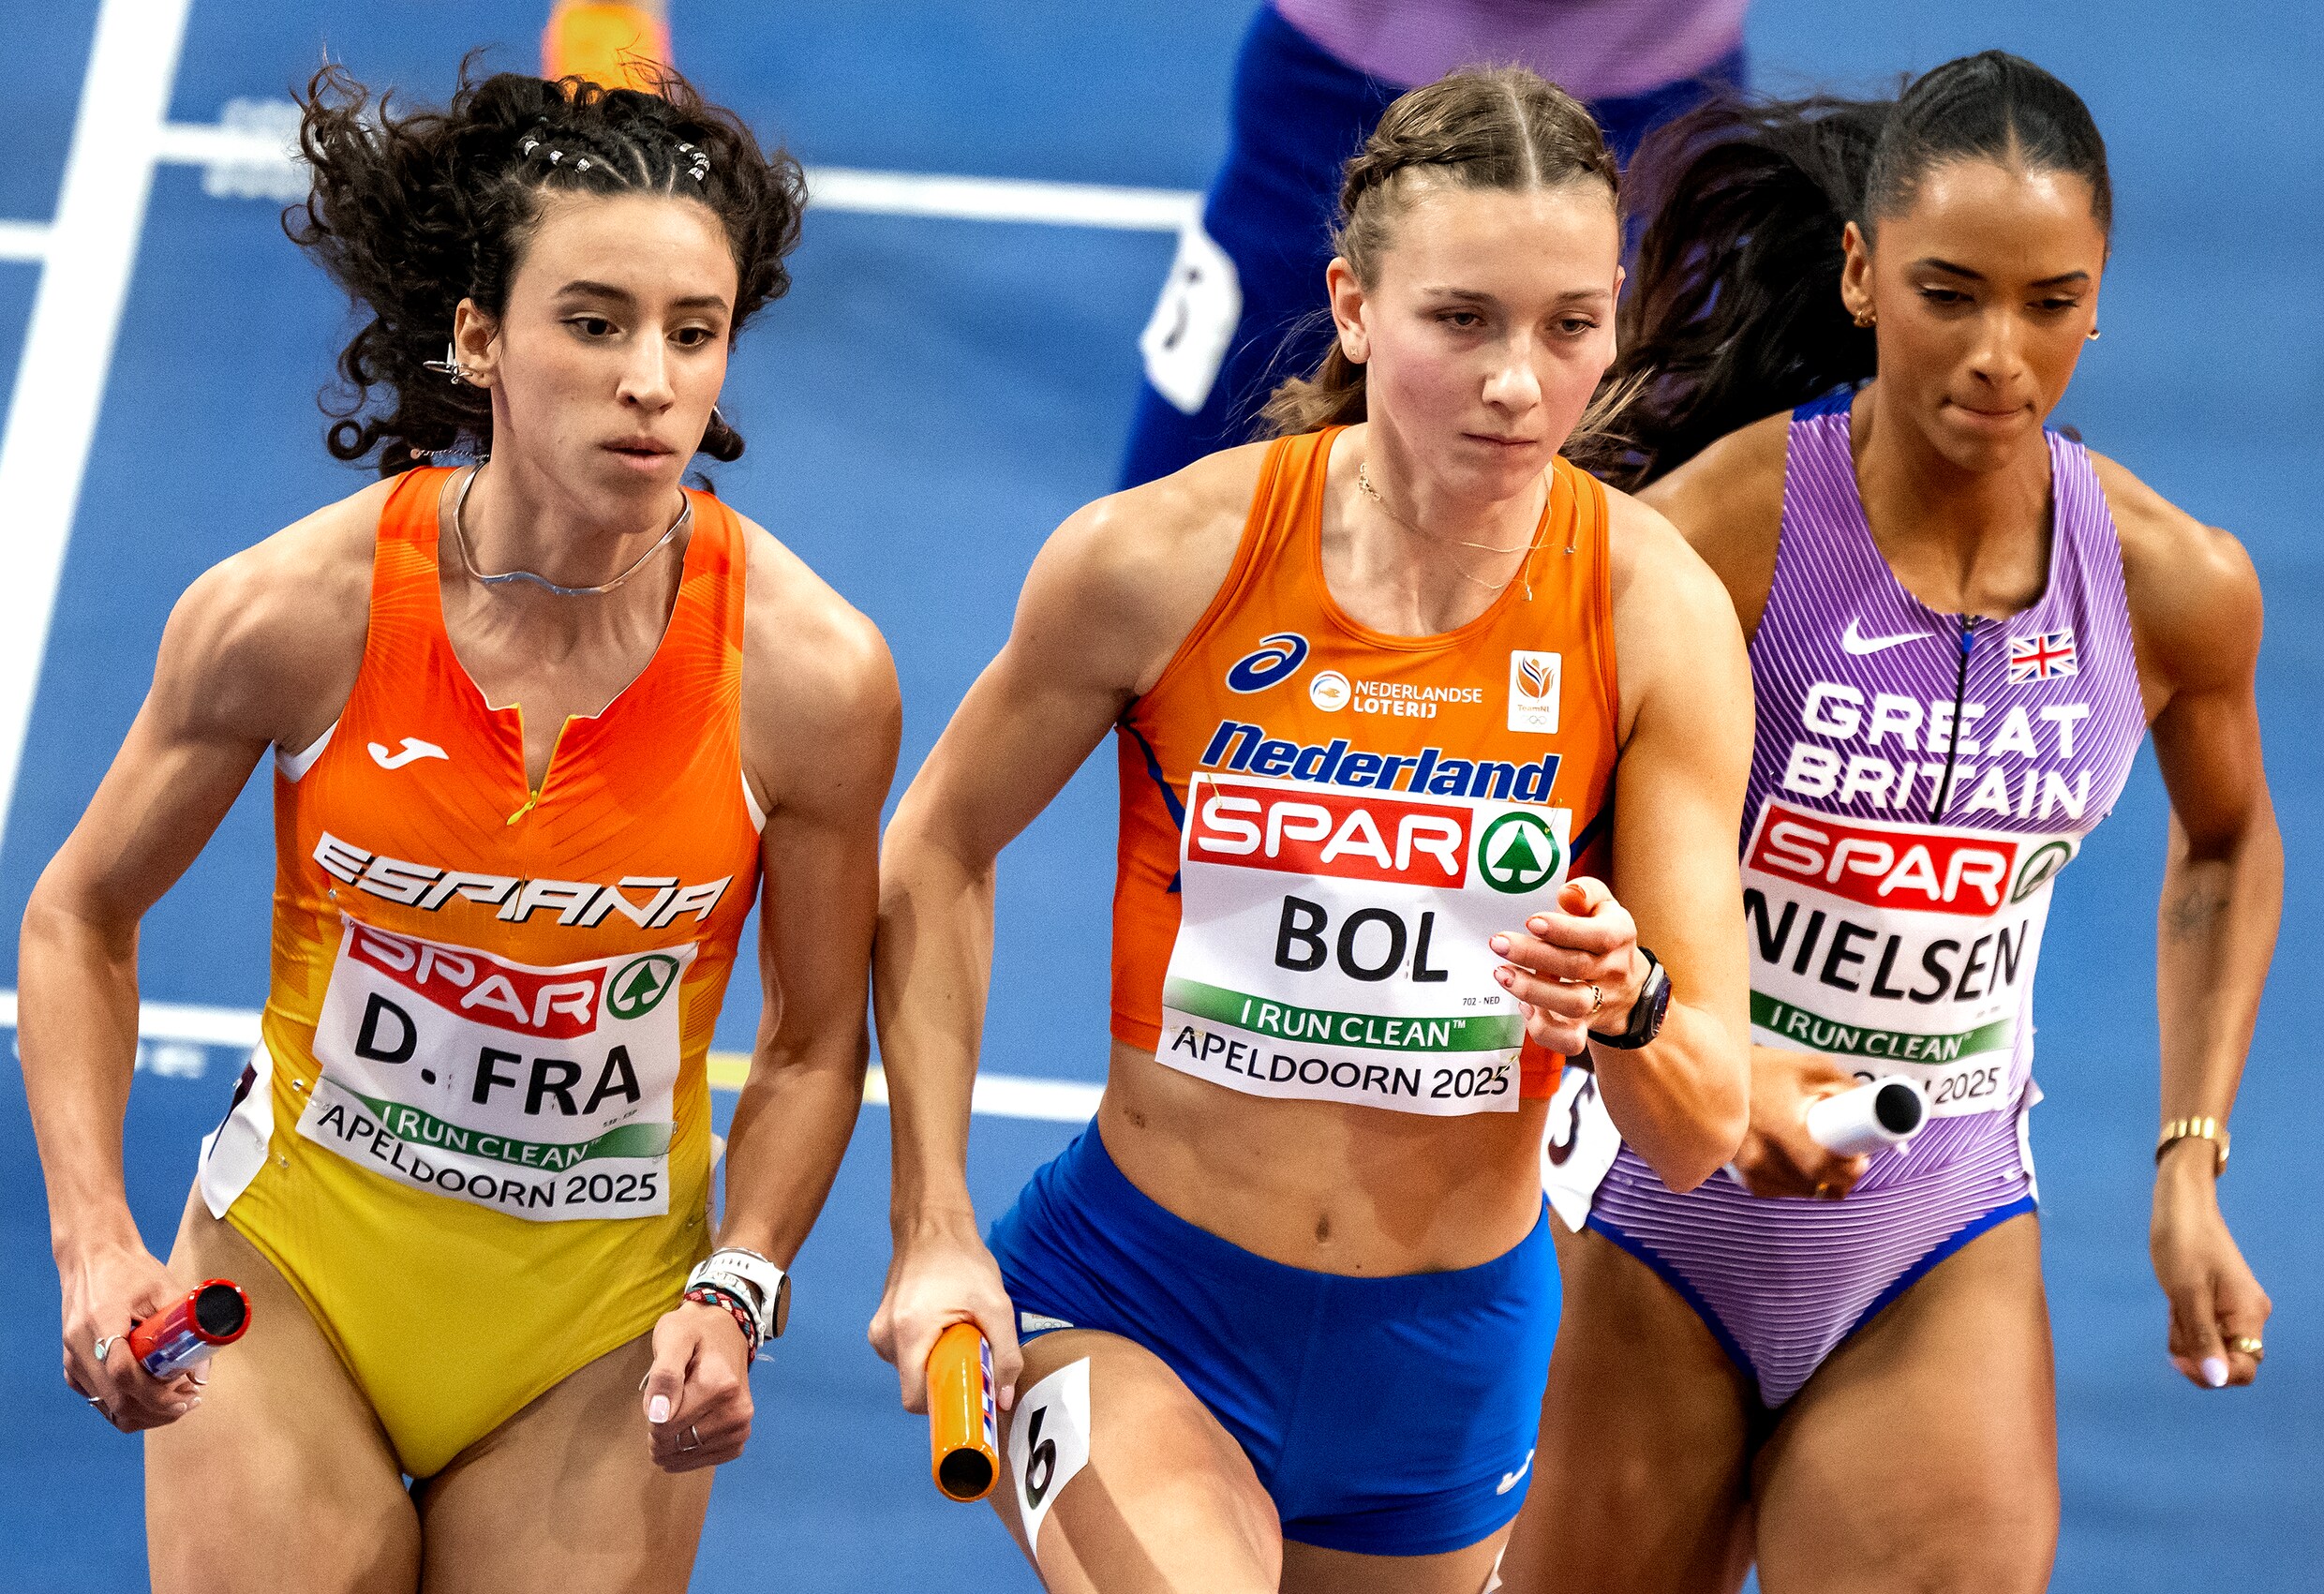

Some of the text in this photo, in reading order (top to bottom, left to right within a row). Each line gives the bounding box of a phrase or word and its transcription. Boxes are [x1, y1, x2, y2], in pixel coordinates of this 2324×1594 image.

[1353, 696, 1438, 719] LOTERIJ
[1355, 680, 1483, 703] NEDERLANDSE
[1800, 681, 2090, 760] GREAT
[1199, 721, 1562, 804] Nederland
[1782, 741, 2093, 821] BRITAIN
[1198, 797, 1464, 876] SPAR
[1763, 823, 2007, 907] SPAR
[312, 831, 734, 929] ESPAÑA
[360, 928, 596, 1028] SPAR
[1275, 895, 1449, 983] BOL
[1743, 887, 2029, 1005] NIELSEN
[1241, 998, 1252, 1018] I
[1258, 1001, 1332, 1039] RUN
[1463, 997, 1477, 1006] 702
[1483, 996, 1500, 1006] NED
[1771, 1006, 1783, 1027] I
[1787, 1010, 1860, 1051] RUN
[354, 992, 641, 1117] D. FRA
[1170, 1025, 1510, 1100] APELDOORN 2025
[1935, 1066, 2002, 1105] 2025
[317, 1105, 557, 1209] APELDOORN
[565, 1172, 658, 1205] 2025
[382, 1106, 391, 1126] I
[397, 1109, 469, 1151] RUN
[1025, 1405, 1056, 1511] 6
